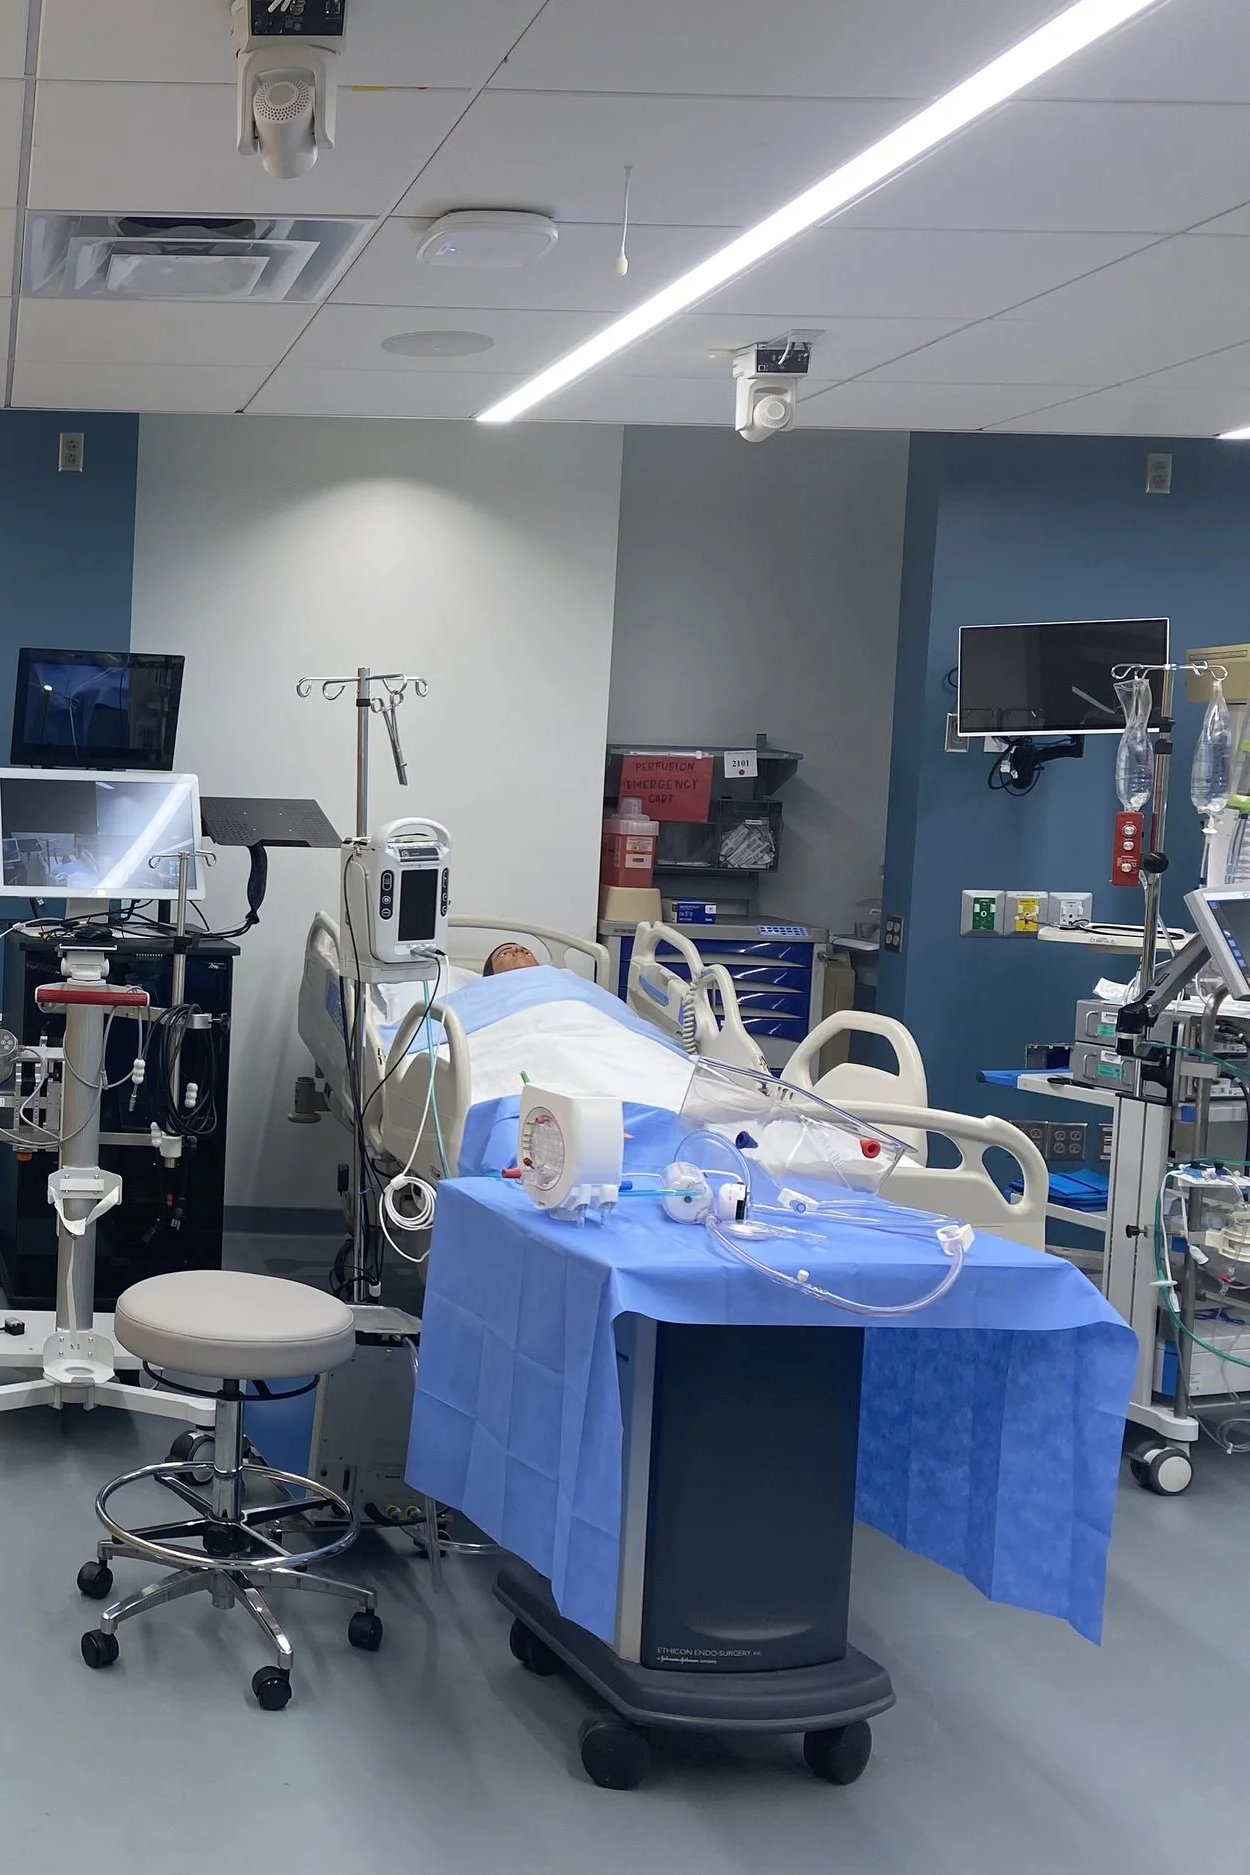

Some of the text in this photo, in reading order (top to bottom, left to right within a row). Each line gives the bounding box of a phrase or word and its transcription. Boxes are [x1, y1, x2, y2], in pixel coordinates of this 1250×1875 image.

[635, 762, 696, 772] PERFUSION
[732, 760, 749, 768] 2101
[626, 780, 698, 790] EMERGENCY
[649, 794, 673, 803] CART
[657, 1647, 692, 1656] ETHICON
